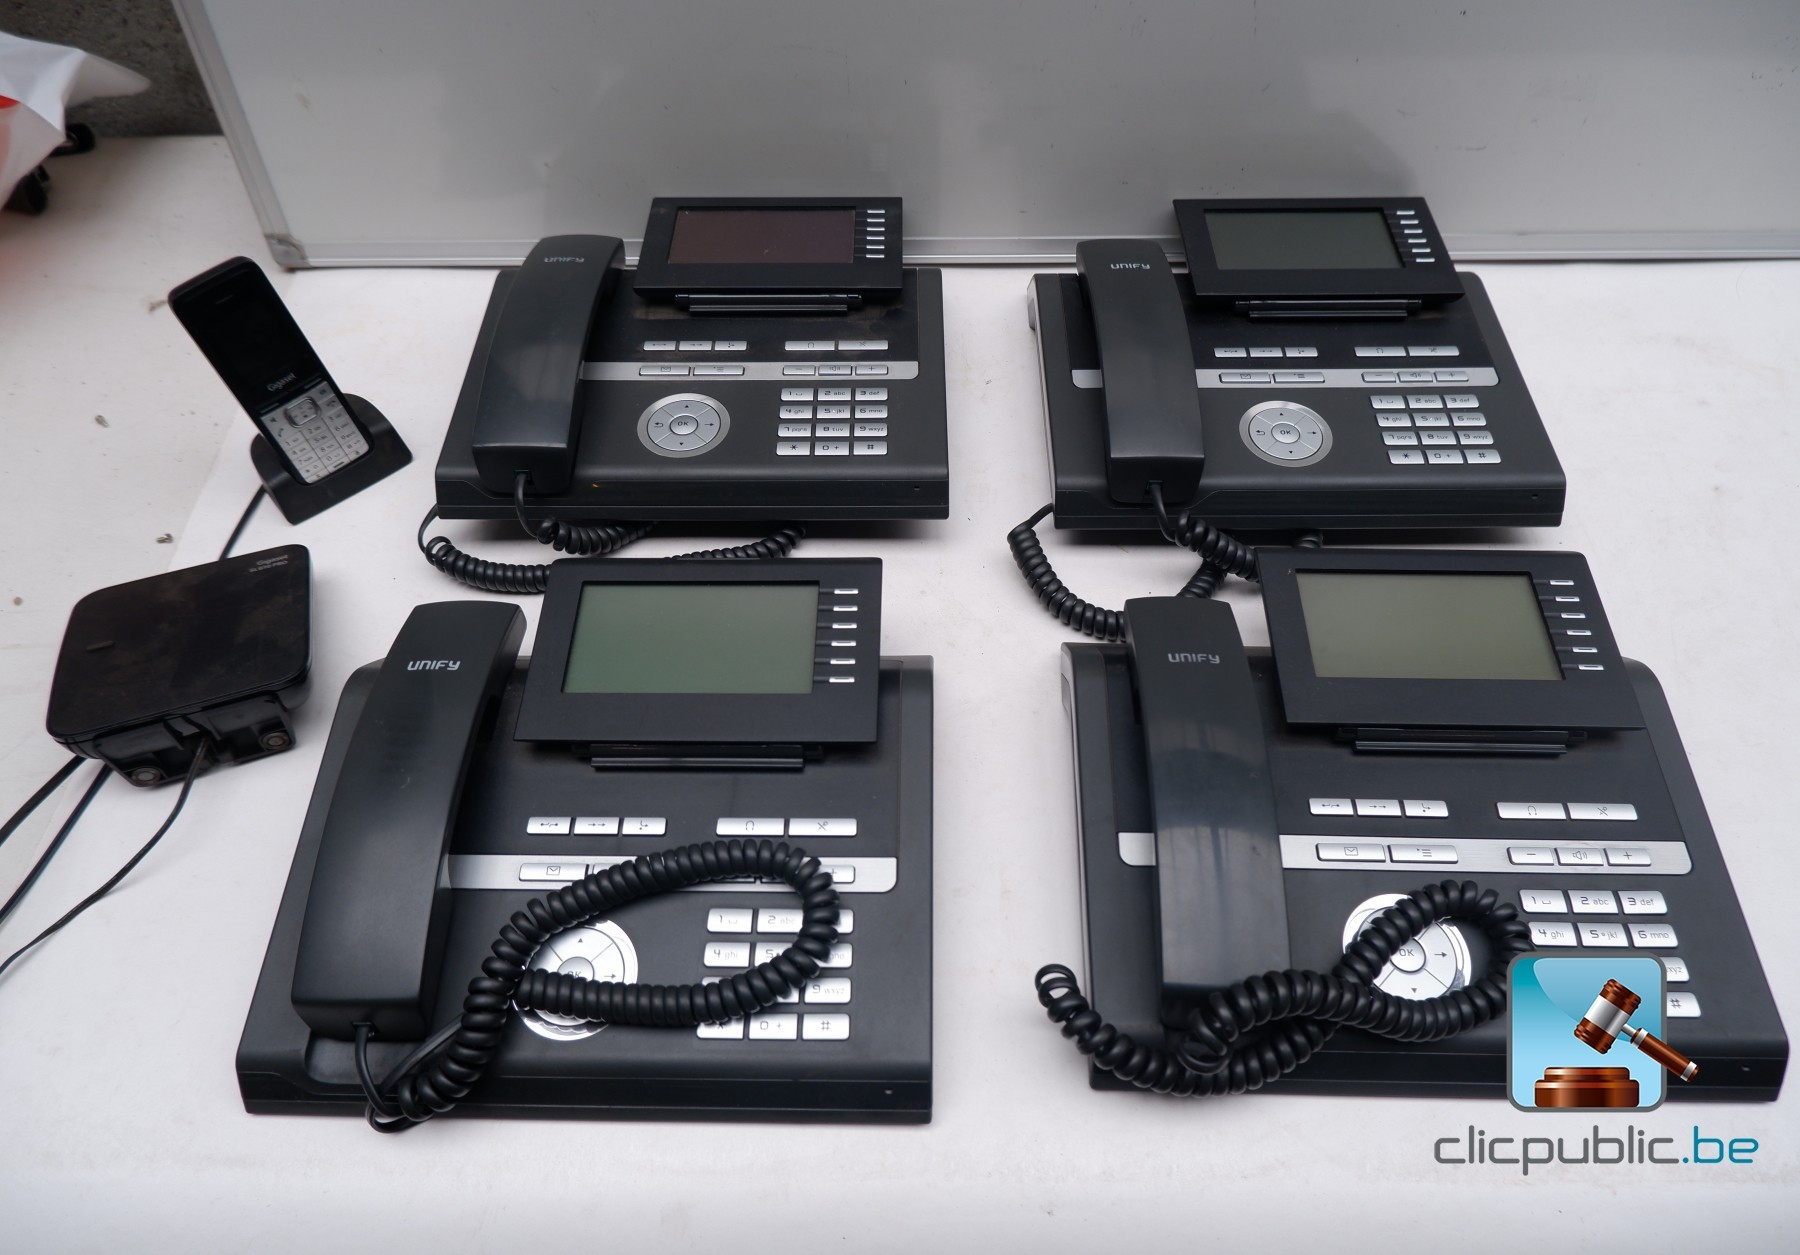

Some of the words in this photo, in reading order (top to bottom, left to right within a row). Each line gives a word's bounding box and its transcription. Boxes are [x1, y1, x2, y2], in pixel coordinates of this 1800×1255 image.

[1531, 896, 1536, 904] 1
[1580, 896, 1590, 905] 2
[1593, 896, 1609, 906] abc
[1628, 897, 1637, 906] 3
[1640, 897, 1654, 906] def
[719, 914, 723, 923] 1
[768, 915, 776, 924] 2
[1538, 929, 1547, 938] 4
[1550, 930, 1565, 939] ghi
[1590, 930, 1600, 939] 5
[1606, 931, 1618, 940] jkl
[1638, 930, 1648, 939] 6
[713, 948, 721, 958] 4
[765, 949, 774, 958] 5
[812, 984, 821, 994] 9
[760, 1021, 769, 1030] 0
